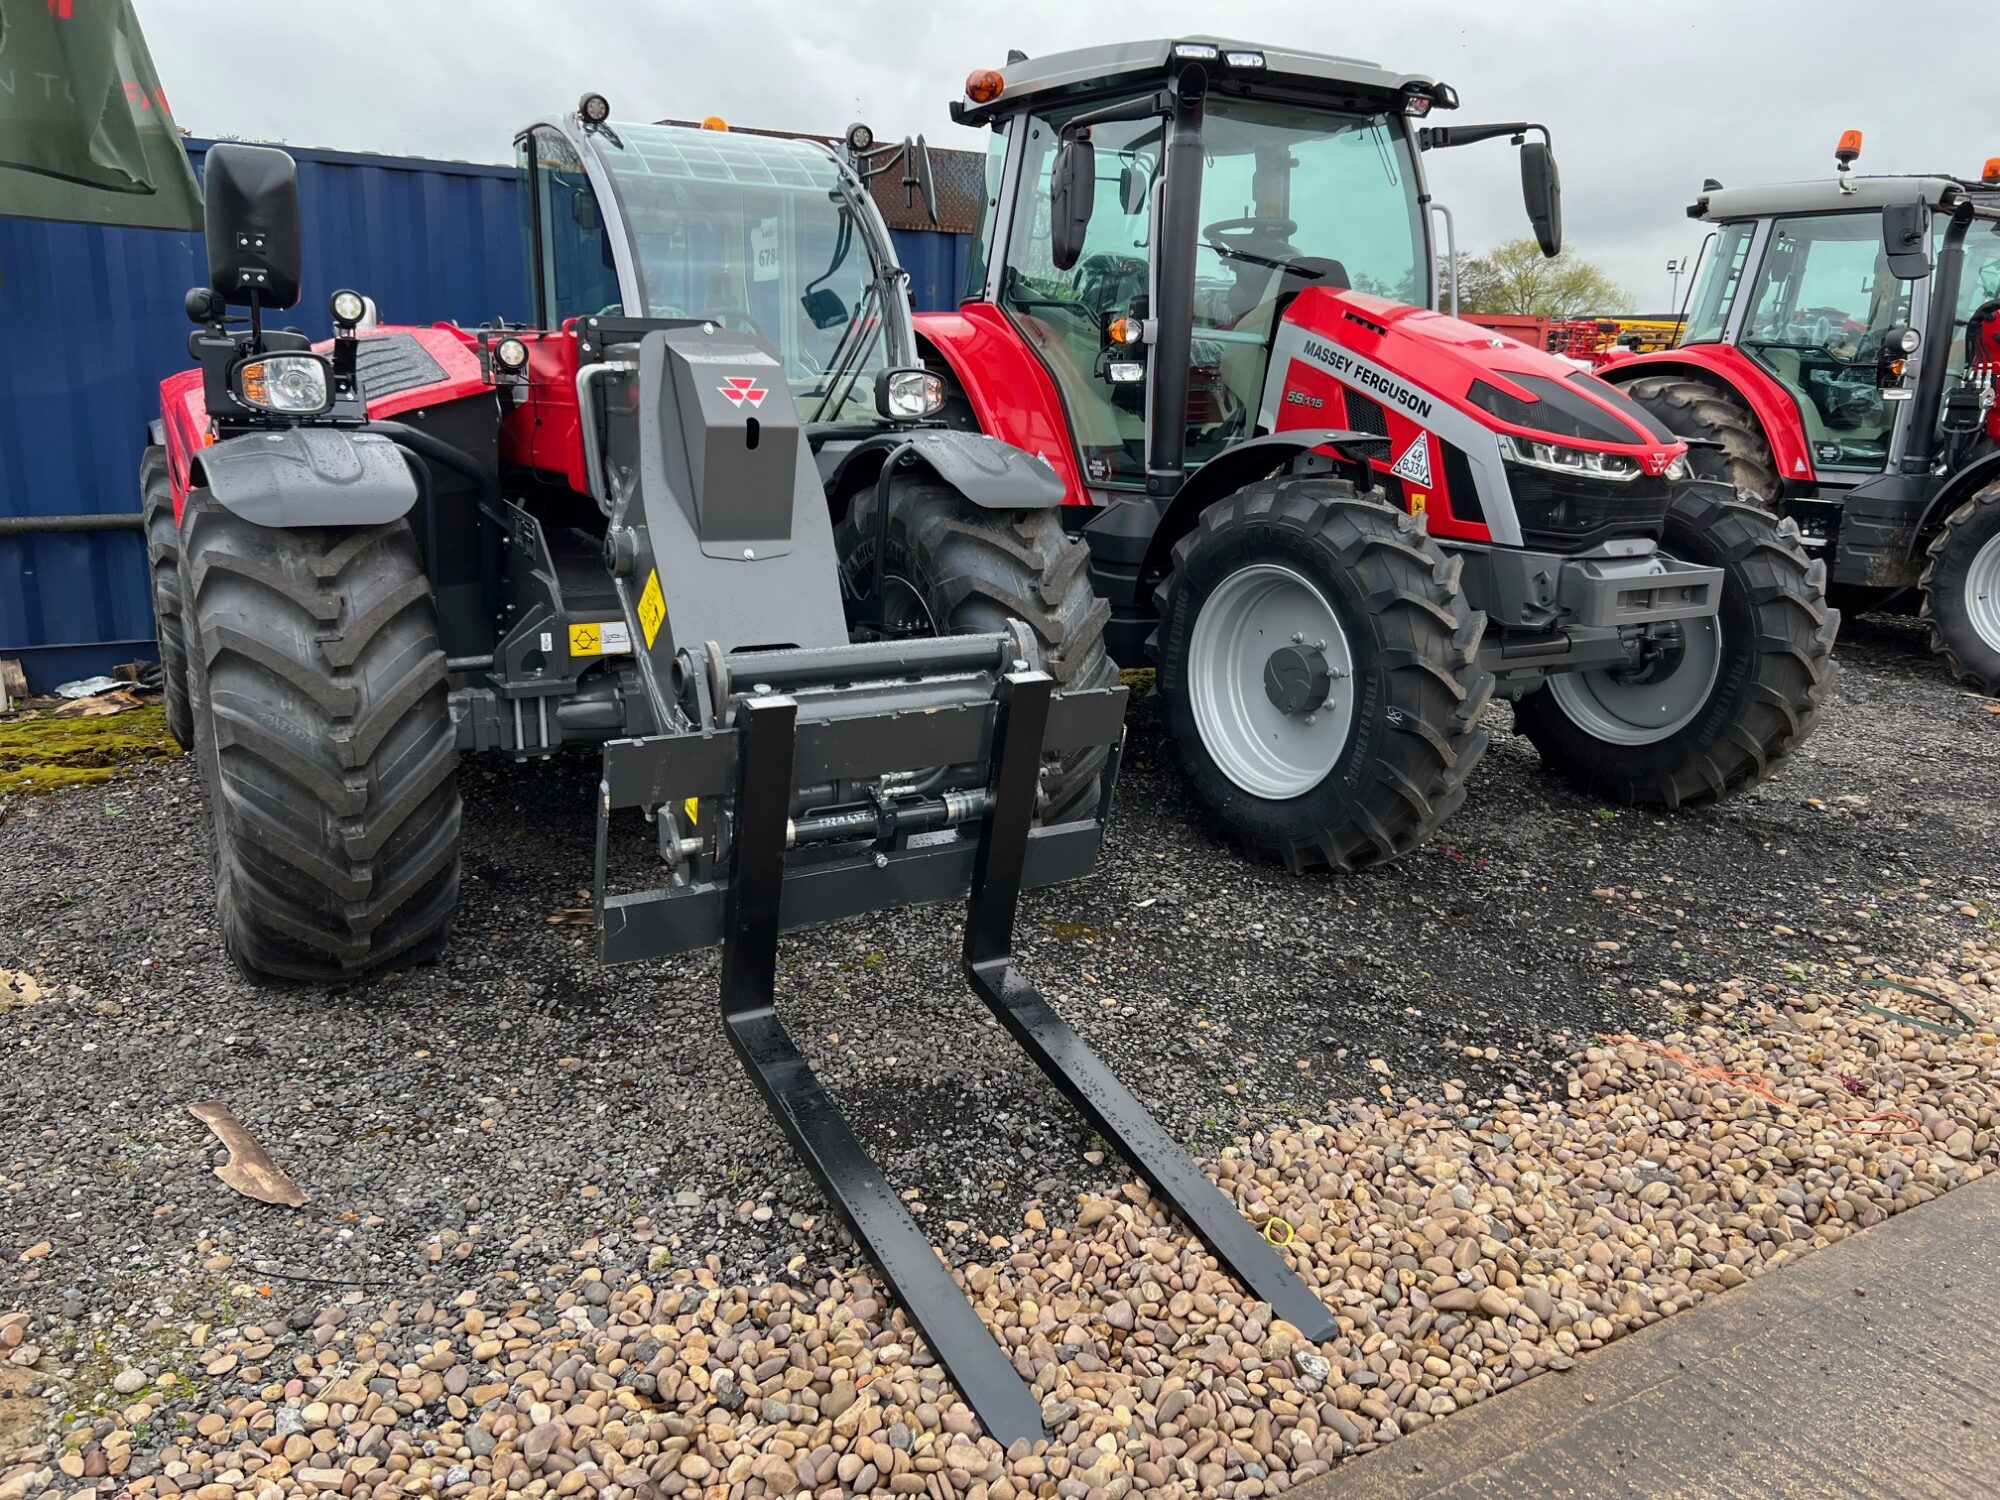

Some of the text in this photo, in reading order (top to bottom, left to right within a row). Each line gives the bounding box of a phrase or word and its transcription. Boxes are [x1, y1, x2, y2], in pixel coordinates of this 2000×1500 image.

[1303, 340, 1432, 418] MASSEY FERGUSON
[1286, 390, 1324, 408] 5S.115
[1411, 449, 1423, 462] 48
